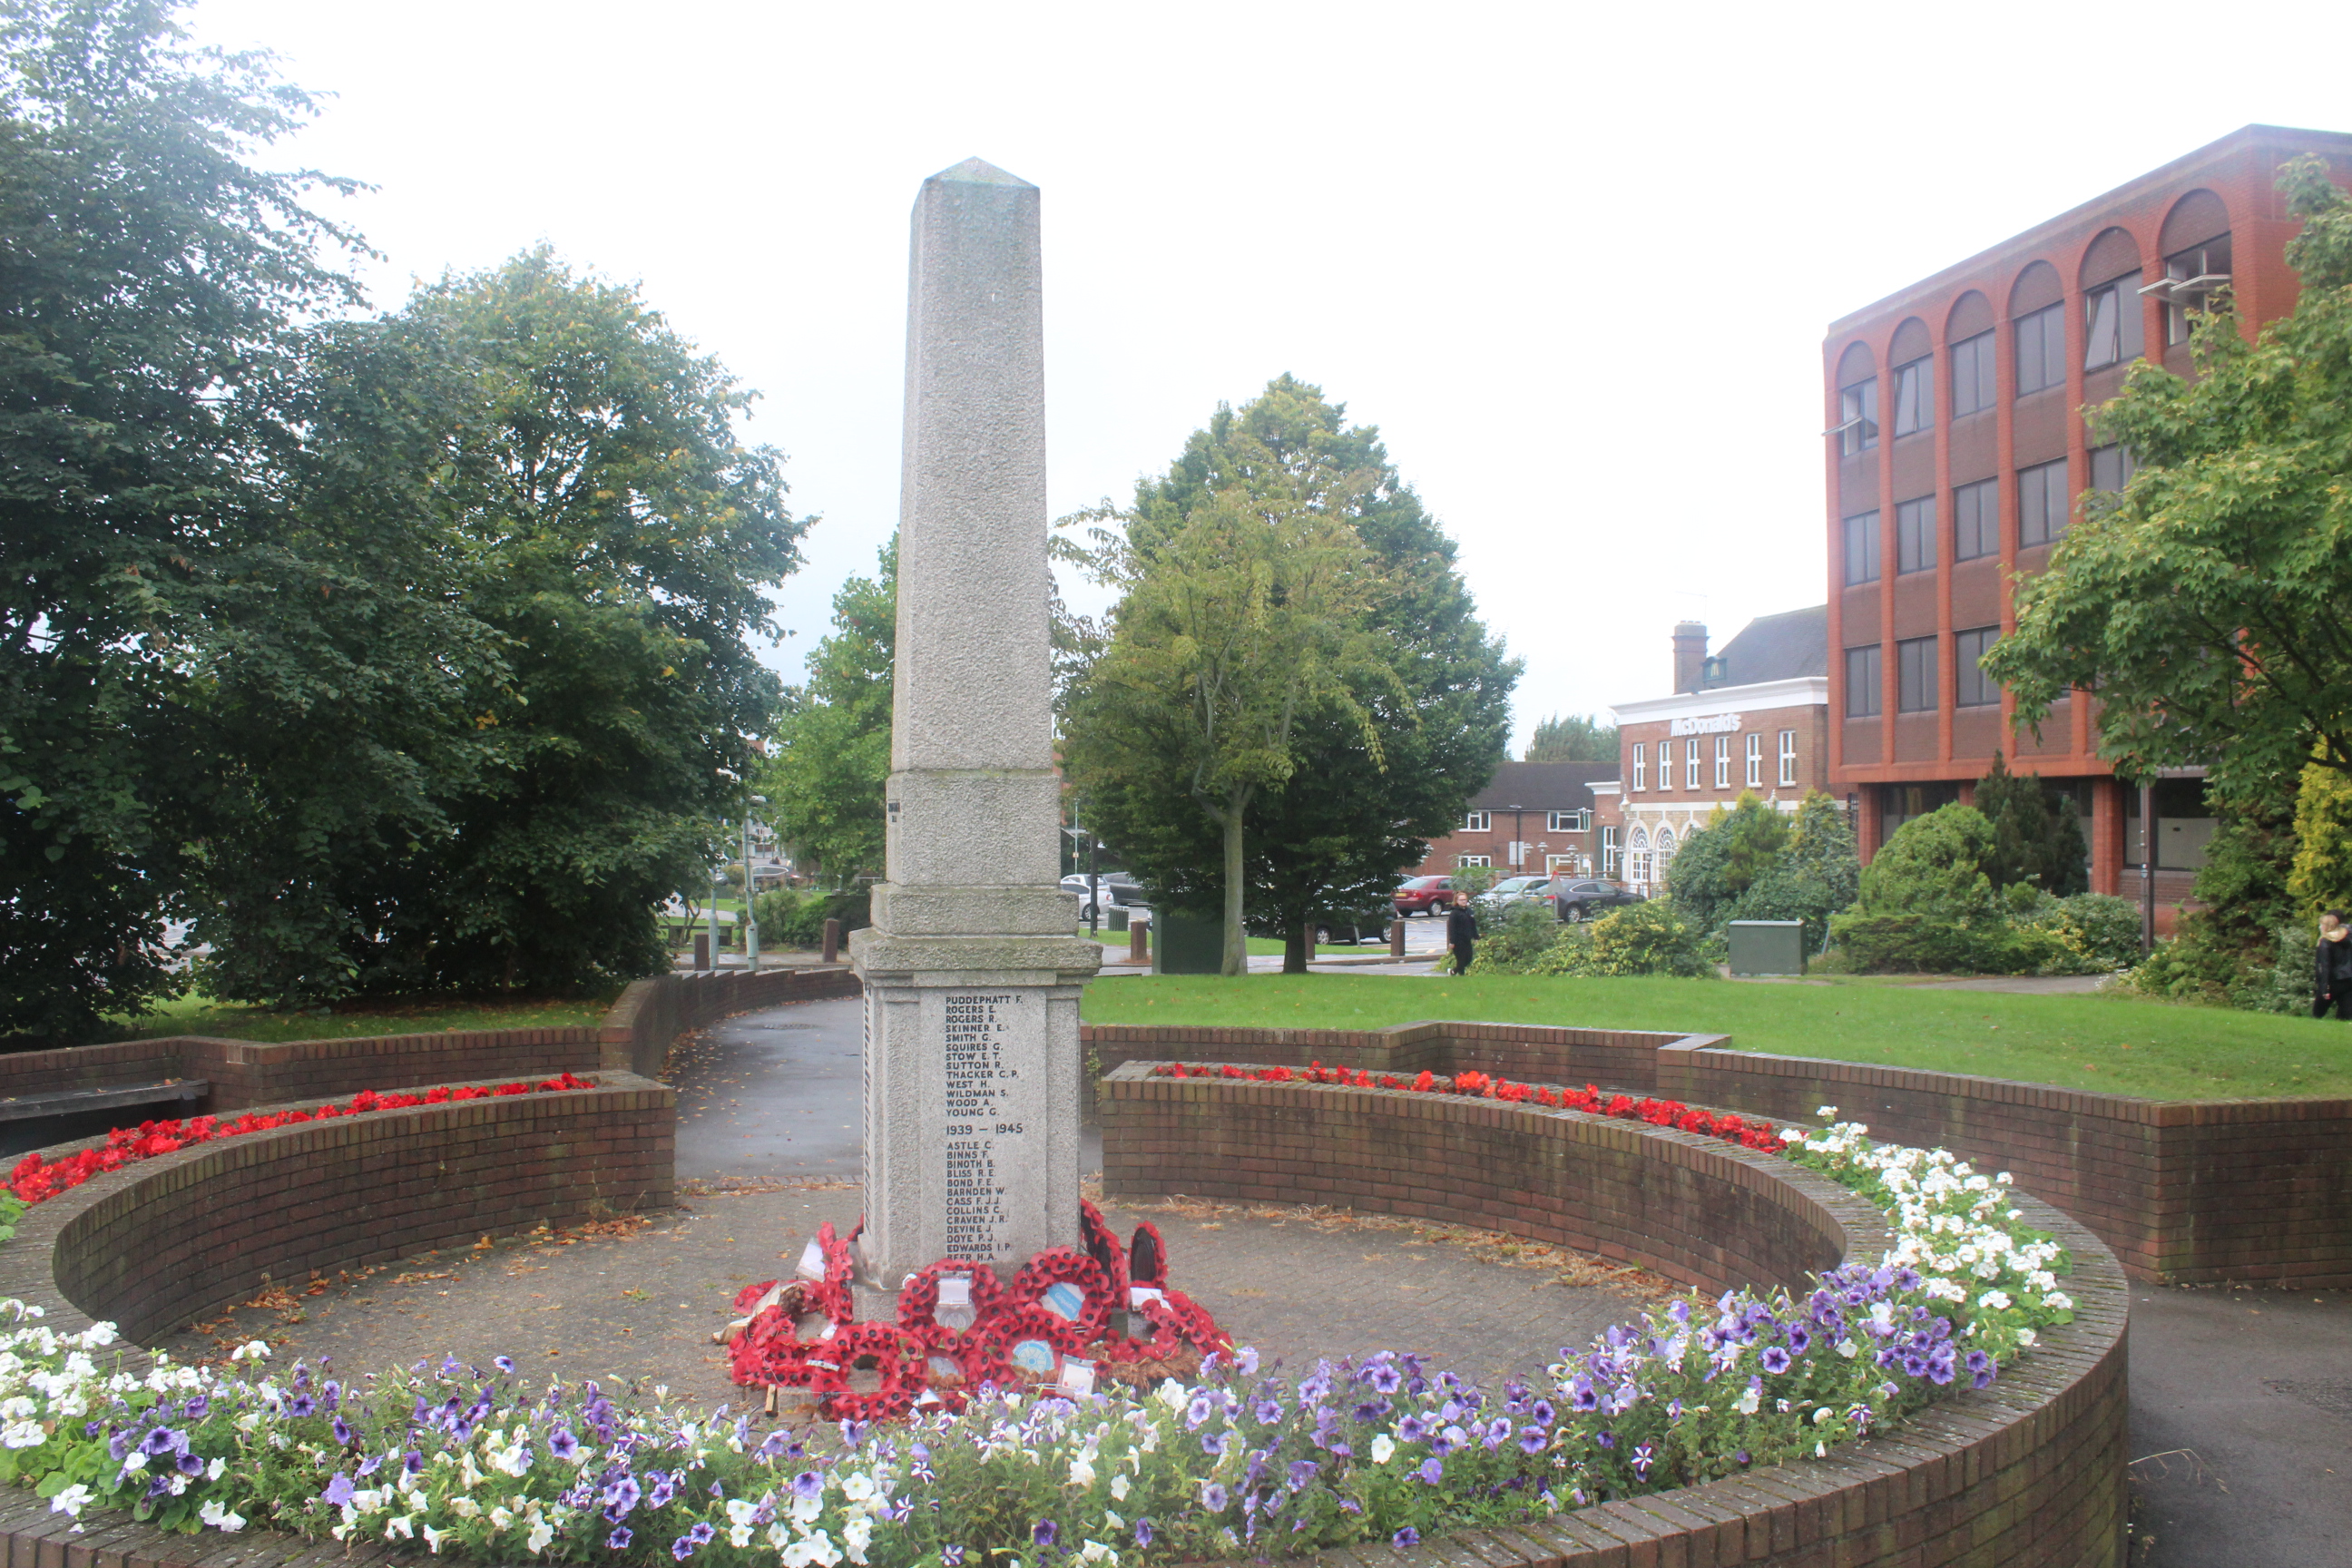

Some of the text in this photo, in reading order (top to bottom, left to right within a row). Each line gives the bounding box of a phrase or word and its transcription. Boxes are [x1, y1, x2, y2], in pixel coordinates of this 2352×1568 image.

[1671, 713, 1741, 737] McDonald's
[946, 995, 1011, 1004] PUDDEPHATT
[946, 1005, 984, 1014] ROGERS
[946, 1014, 984, 1024] ROGERS
[946, 1024, 990, 1033] SKINNER
[946, 1034, 976, 1043] SMITH
[946, 1043, 987, 1052] SQUIRES
[946, 1053, 976, 1061] STOW
[946, 1062, 989, 1070] SUTTON
[946, 1071, 994, 1080] THACKER
[946, 1081, 974, 1089] WEST
[946, 1090, 995, 1098] WILDMAN
[946, 1099, 978, 1107] WOOD
[946, 1108, 984, 1117] YOUNG
[946, 1125, 973, 1135] 1939
[995, 1123, 1024, 1134] 1945
[946, 1142, 979, 1151] ASTLE
[946, 1152, 978, 1160] BINNS
[946, 1161, 982, 1169] BINOTH
[946, 1170, 972, 1178] BLISS
[946, 1179, 974, 1188] BOND
[946, 1188, 992, 1196] BARNDEN
[946, 1198, 973, 1206] CASS
[946, 1207, 989, 1215] COLLINS
[946, 1216, 985, 1225] CRAVEN
[946, 1225, 983, 1234] DEVINE
[946, 1235, 974, 1243] DOYE
[946, 1244, 993, 1252] EDWARDS
